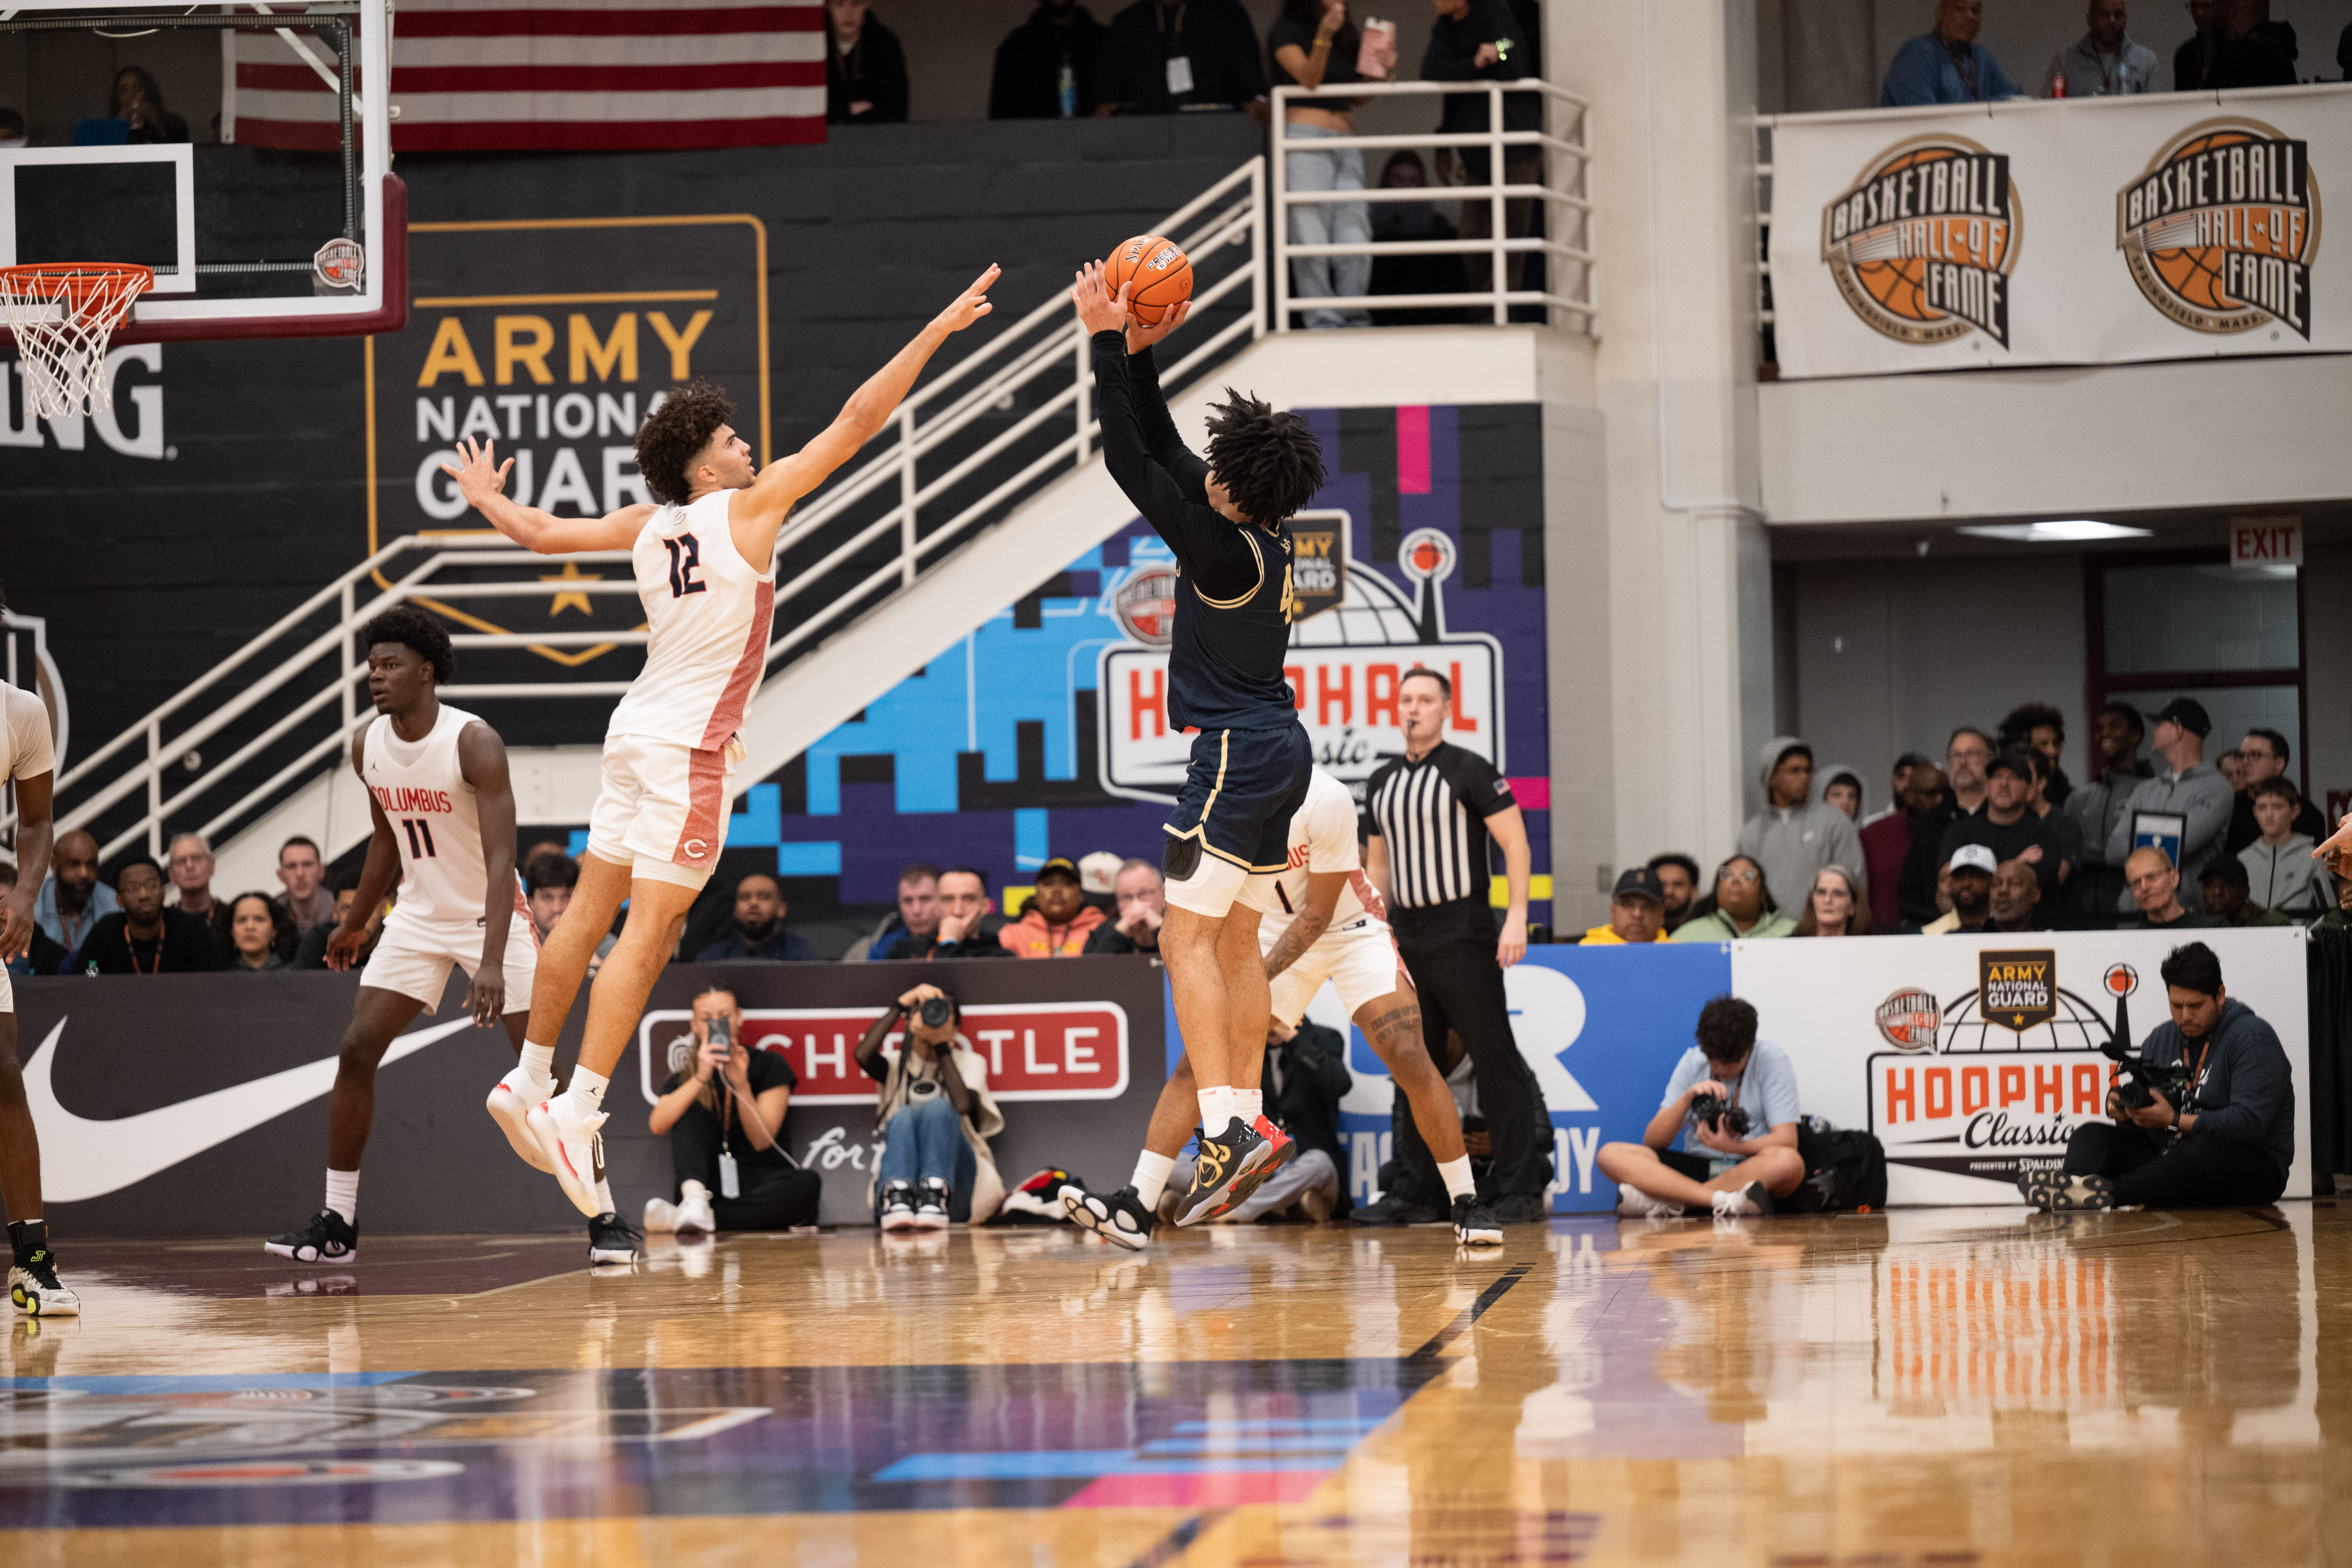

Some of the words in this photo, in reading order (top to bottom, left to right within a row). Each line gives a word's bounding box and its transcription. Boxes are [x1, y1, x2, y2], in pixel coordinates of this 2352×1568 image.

[1833, 157, 2001, 240] BASKETBALL
[2128, 144, 2300, 227] BASKETBALL
[1125, 235, 1151, 263] SPAL
[1898, 219, 1955, 259] HALL
[1968, 219, 2002, 267] OF
[2196, 208, 2254, 248] HALL
[2268, 208, 2301, 257] OF
[1930, 262, 2002, 338] FAME
[2229, 252, 2303, 329] FAME
[417, 311, 714, 388] ARMY
[416, 391, 667, 442] NATION
[415, 447, 656, 520] GAR
[662, 531, 707, 598] 12
[2236, 528, 2295, 559] EXIT
[1279, 562, 1294, 626] 4
[401, 818, 436, 860] 11
[683, 837, 708, 859] C
[1988, 981, 2048, 992] NATIONAL
[1989, 965, 2047, 981] ARMY
[1988, 992, 2048, 1007] GUARD
[1886, 1064, 2119, 1125] HOOPHA
[1965, 1111, 2074, 1148] Classic
[2018, 1157, 2065, 1174] SPALDIN
